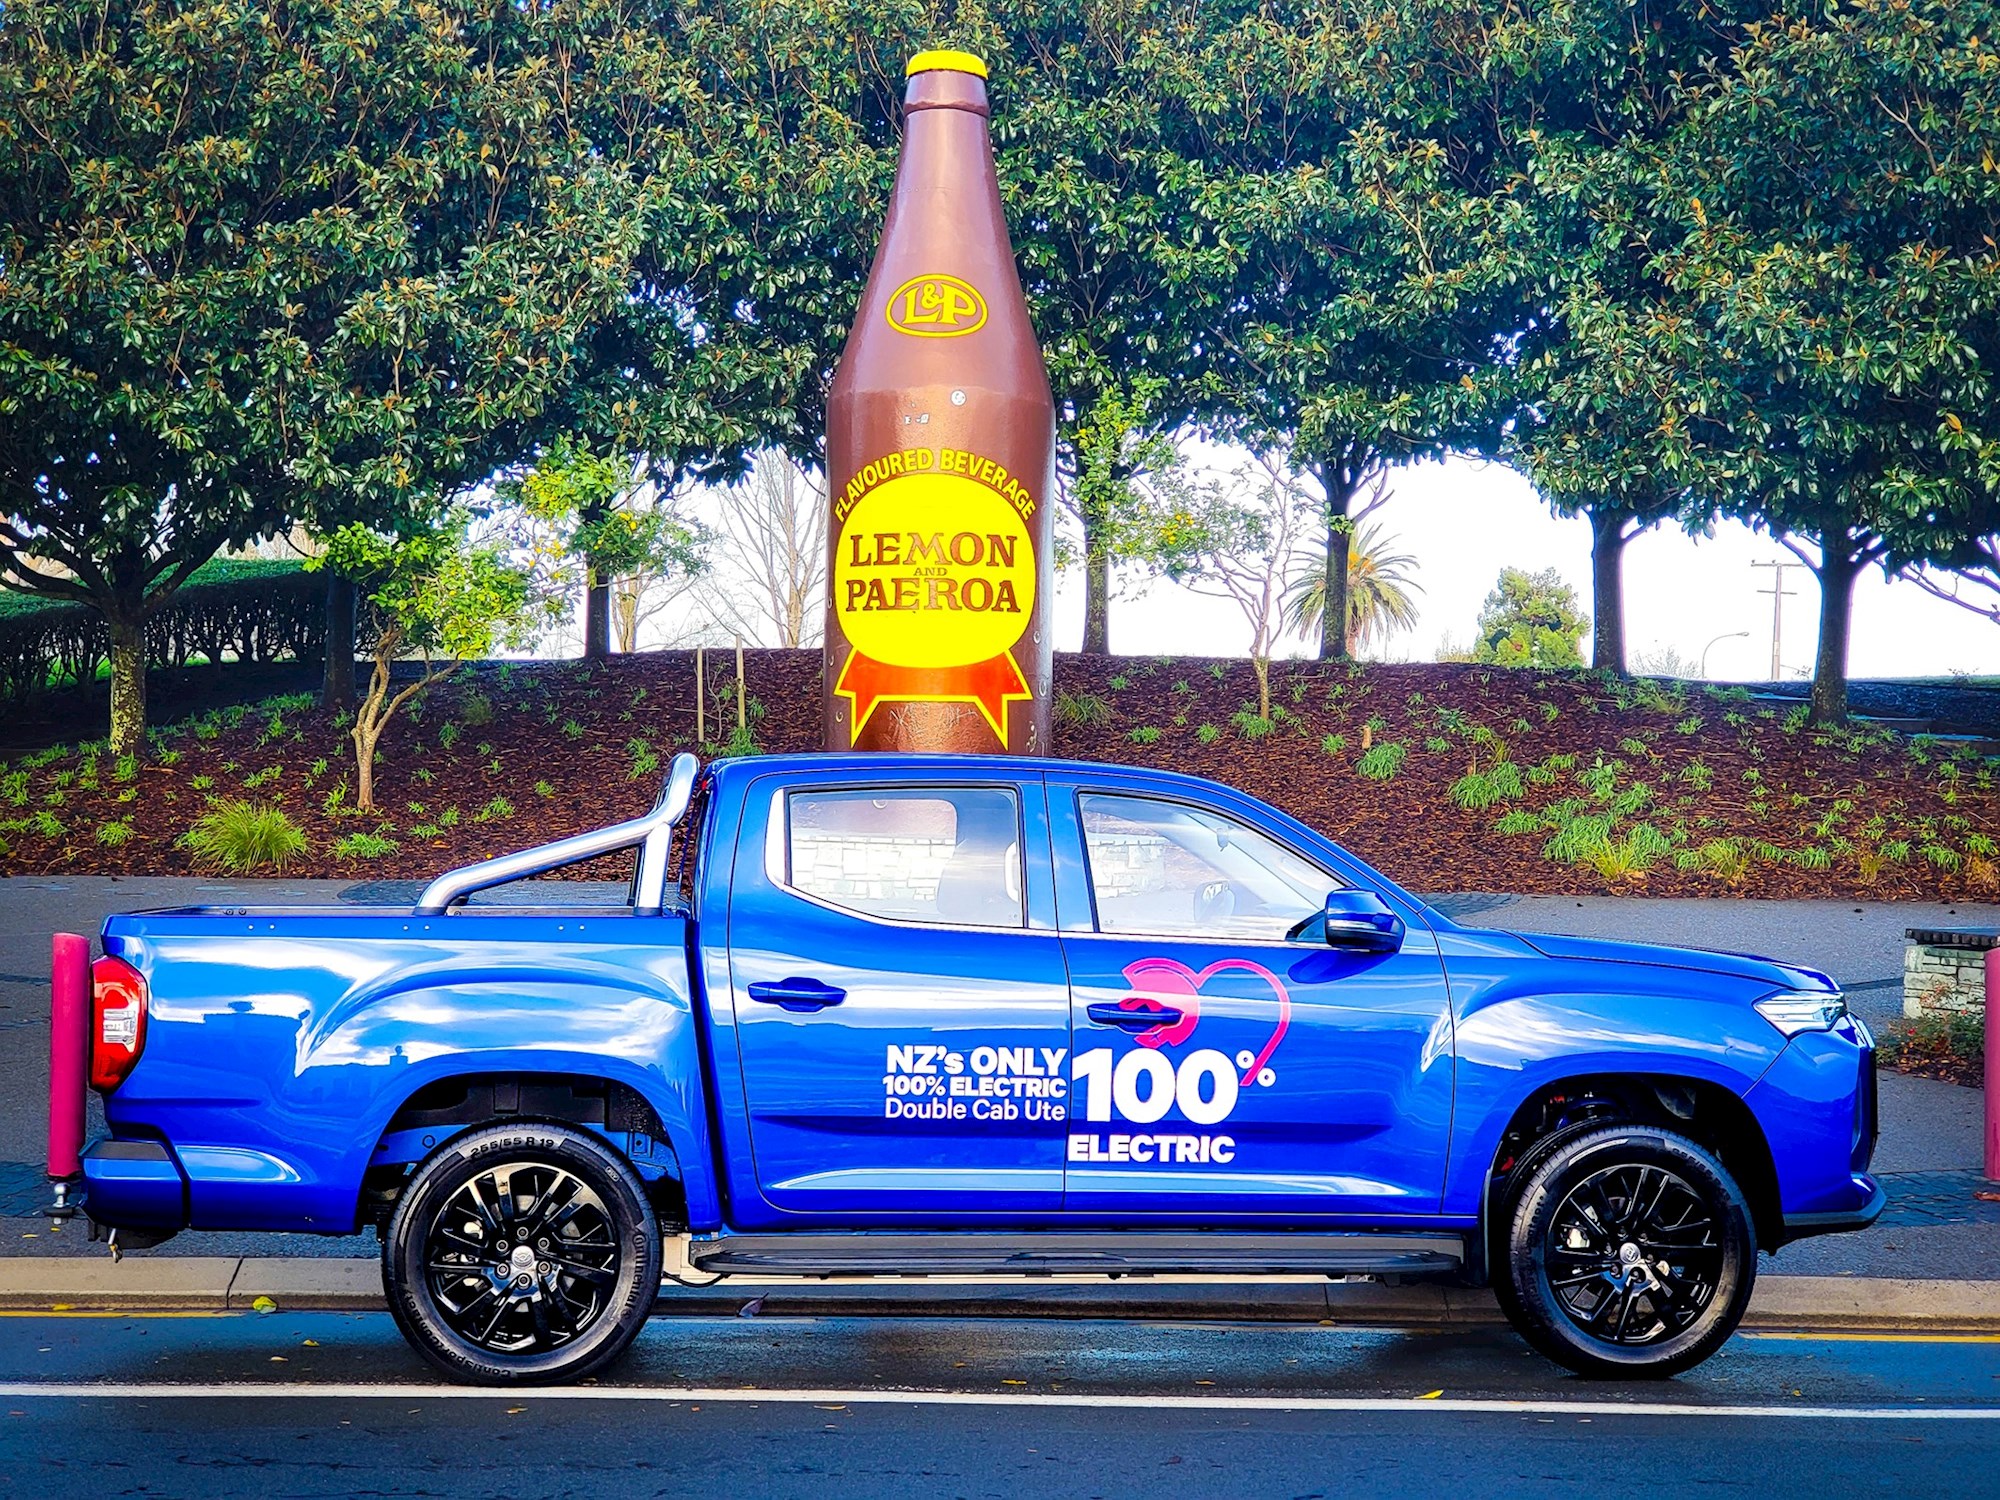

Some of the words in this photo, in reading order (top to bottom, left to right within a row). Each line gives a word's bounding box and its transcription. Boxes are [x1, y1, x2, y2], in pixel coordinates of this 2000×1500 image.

[902, 282, 977, 325] L&P
[834, 447, 935, 523] FLAVOURED
[939, 448, 1037, 521] BEVERAGE
[850, 532, 1018, 568] LEMON
[913, 567, 948, 577] AND
[845, 578, 1021, 613] PAEROA
[886, 1045, 965, 1075] NZ's
[970, 1047, 1068, 1076] ONLY
[882, 1076, 946, 1097] 100%
[949, 1077, 1068, 1098] ELECTRIC
[885, 1097, 967, 1120] Double
[972, 1098, 1019, 1121] Cab
[1024, 1099, 1067, 1121] Ute
[470, 1137, 522, 1157] 255/55
[540, 1138, 555, 1148] 19
[1067, 1134, 1236, 1164] ELECTRIC
